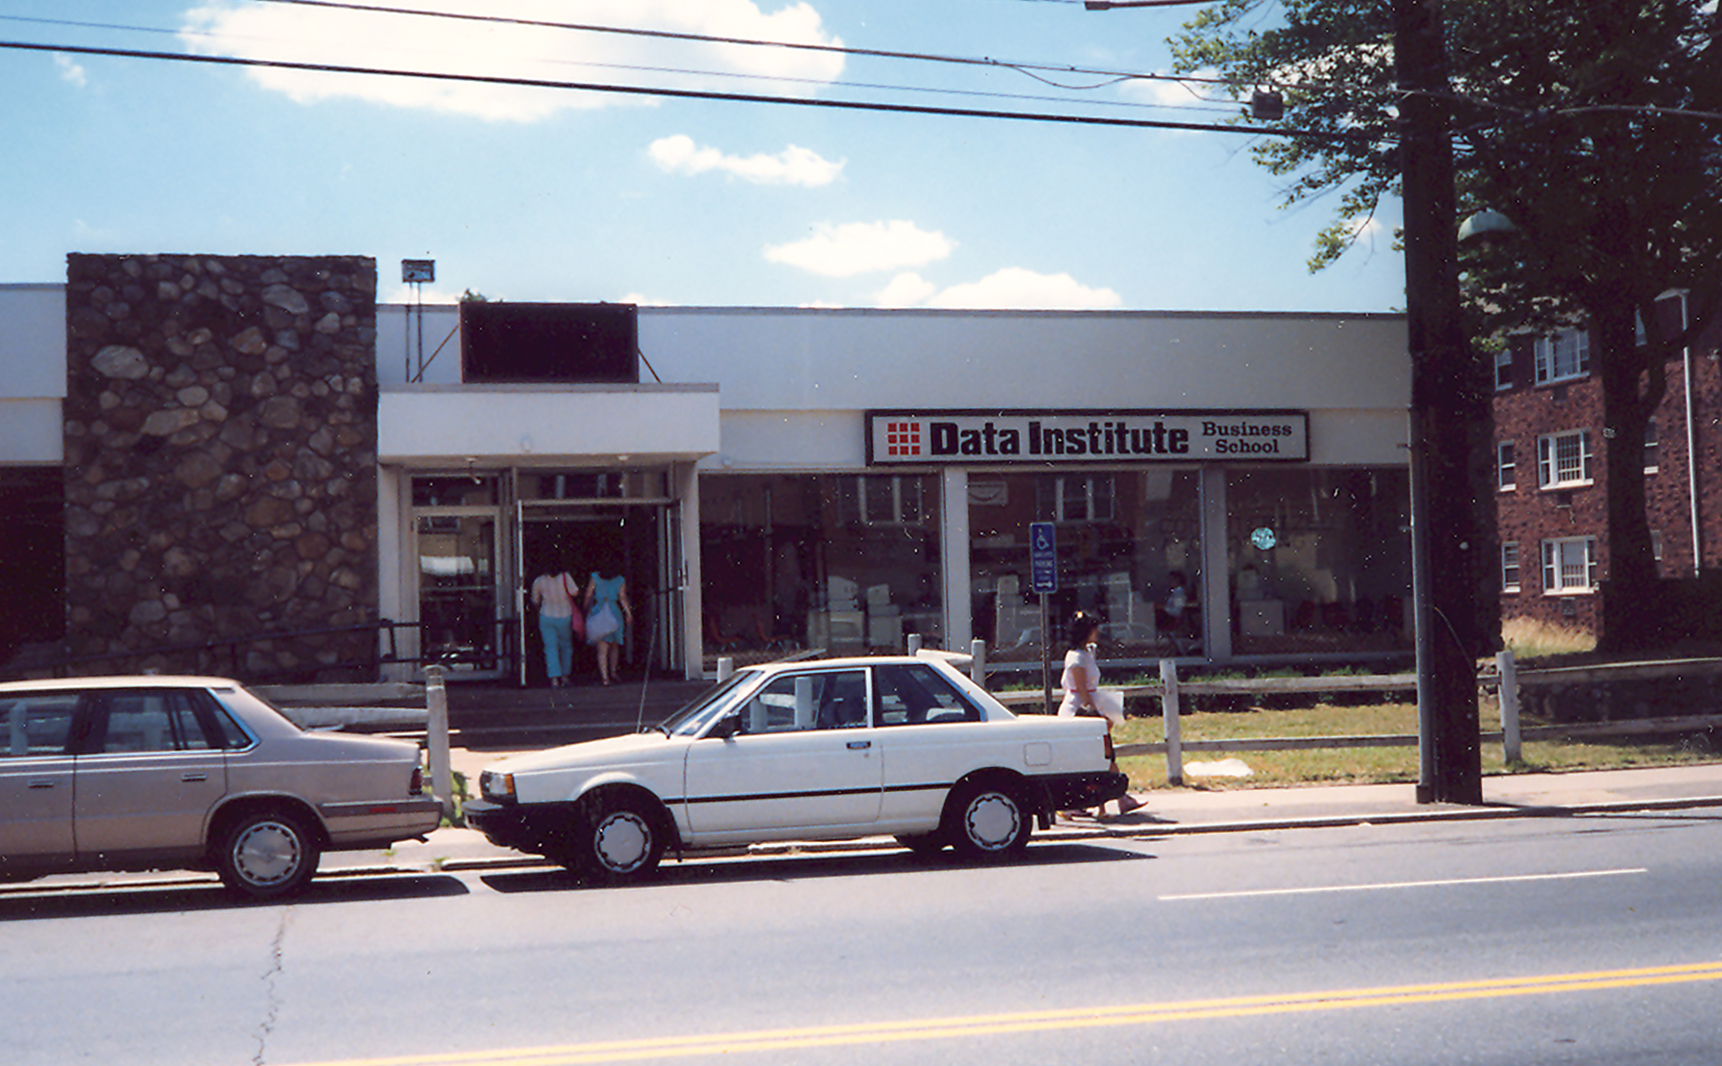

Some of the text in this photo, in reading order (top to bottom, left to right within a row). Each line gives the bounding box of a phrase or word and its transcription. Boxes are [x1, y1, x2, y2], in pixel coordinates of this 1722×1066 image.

[1202, 421, 1292, 437] Business
[930, 421, 1189, 455] Data Institute
[1215, 438, 1279, 454] School
